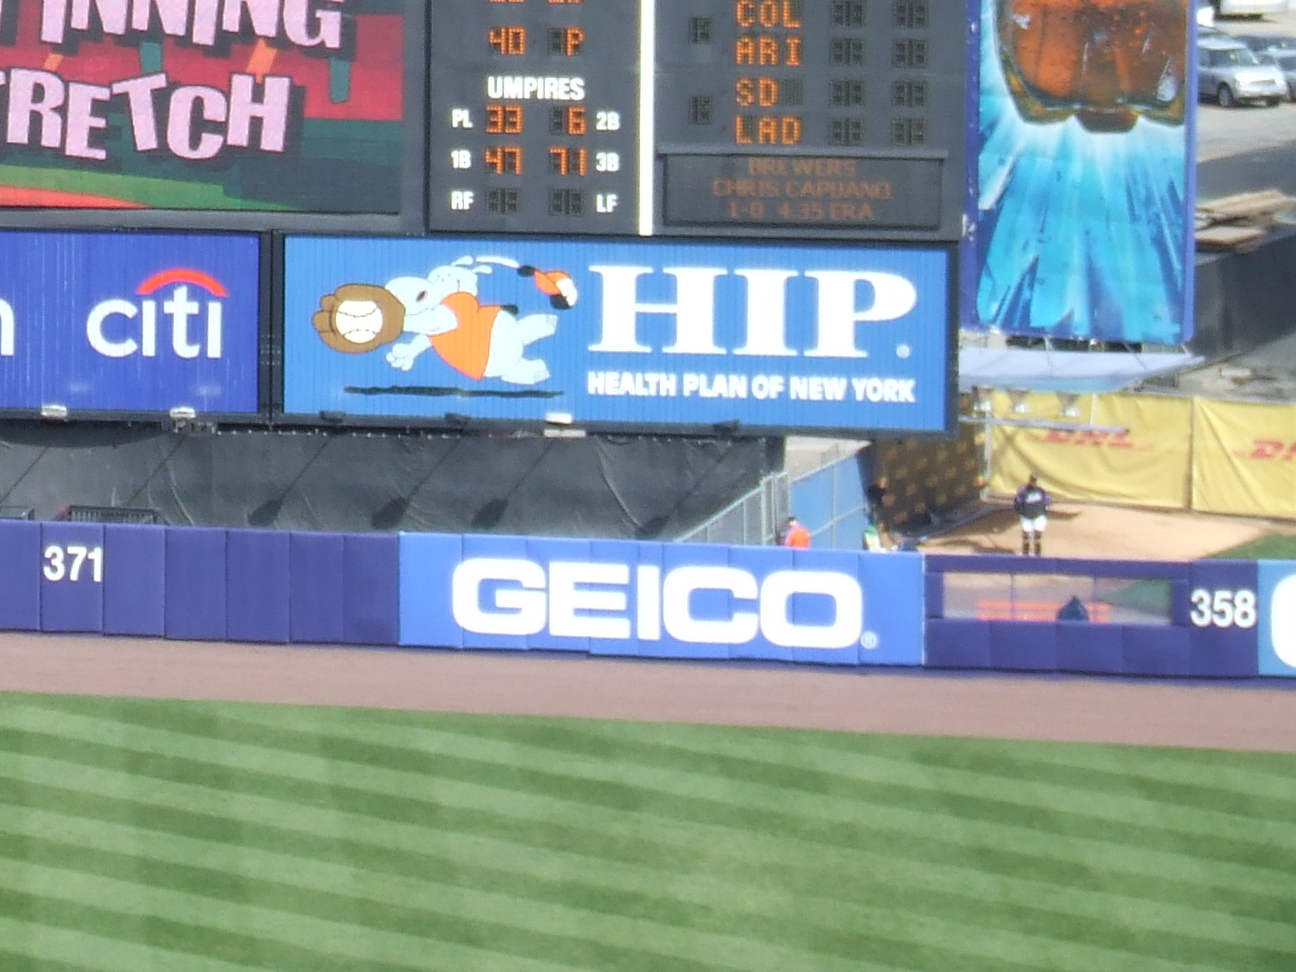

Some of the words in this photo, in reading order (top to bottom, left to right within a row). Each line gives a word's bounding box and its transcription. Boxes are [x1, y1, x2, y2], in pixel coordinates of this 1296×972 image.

[489, 26, 526, 54] 40
[565, 27, 584, 55] P
[736, 36, 800, 66] ARI
[488, 77, 584, 100] UMPIRES
[737, 77, 779, 107] SD
[452, 109, 472, 127] PL
[487, 104, 523, 134] 33
[567, 105, 587, 135] 6
[596, 112, 619, 130] 2B
[736, 116, 801, 144] LAD
[451, 150, 471, 168] 1B
[485, 146, 522, 174] 47
[550, 146, 587, 175] 71
[596, 153, 619, 171] 3B
[452, 191, 473, 209] RF
[597, 194, 617, 212] LF
[87, 286, 221, 358] citi
[589, 266, 916, 357] HIP
[588, 372, 676, 396] HEALTH
[683, 374, 746, 398] PLAN
[752, 375, 784, 399] OF
[790, 377, 847, 400] NEW
[852, 378, 914, 402] YORK
[44, 546, 102, 581] 371
[452, 557, 864, 648] GEICO
[1192, 590, 1256, 627] 358
